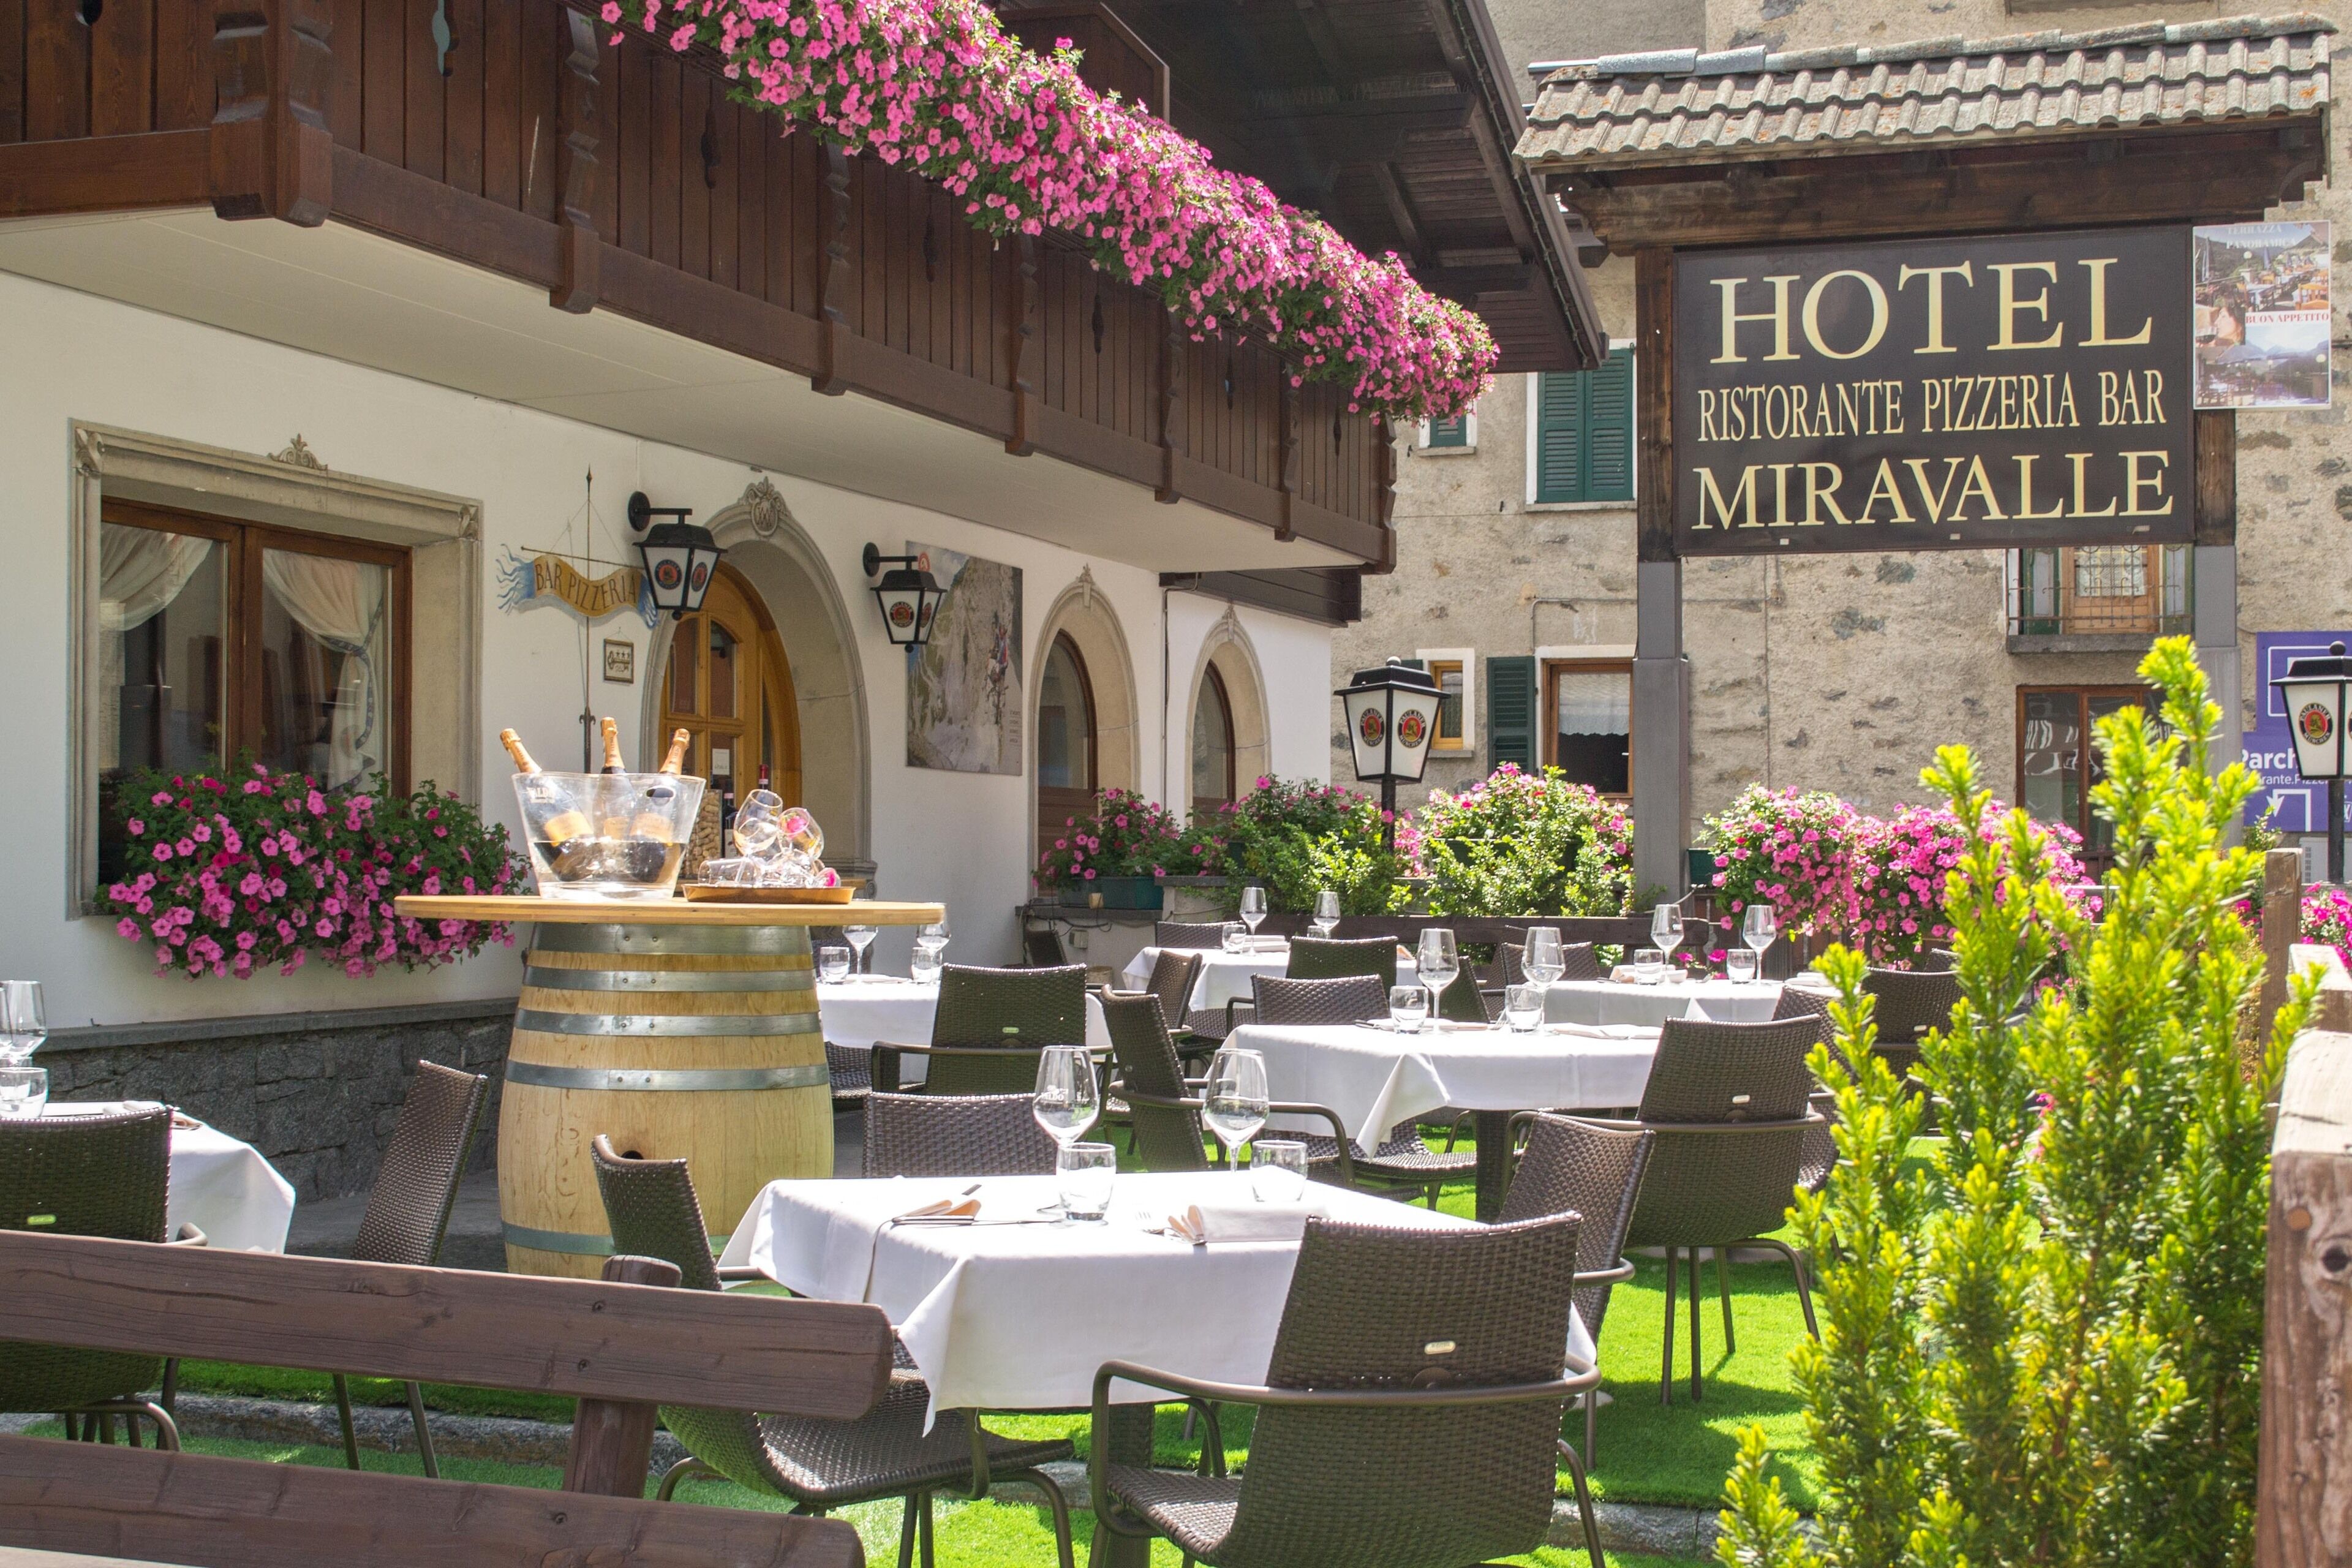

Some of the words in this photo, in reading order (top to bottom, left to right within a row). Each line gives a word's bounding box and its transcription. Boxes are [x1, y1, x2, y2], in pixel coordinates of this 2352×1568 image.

[2226, 238, 2297, 249] PANORAMICA
[2228, 224, 2282, 235] TERRAZZA
[1709, 258, 2152, 364] HOTEL
[2245, 314, 2274, 324] BUON
[2278, 312, 2329, 323] APPETITO
[1697, 379, 1904, 442] RISTORANTE
[1921, 372, 2080, 432] PIZZERIA
[2098, 369, 2166, 426] BAR
[1691, 450, 2173, 530] MIRAVALLE
[535, 561, 563, 596] BAR
[567, 573, 636, 611] PIZZERIA
